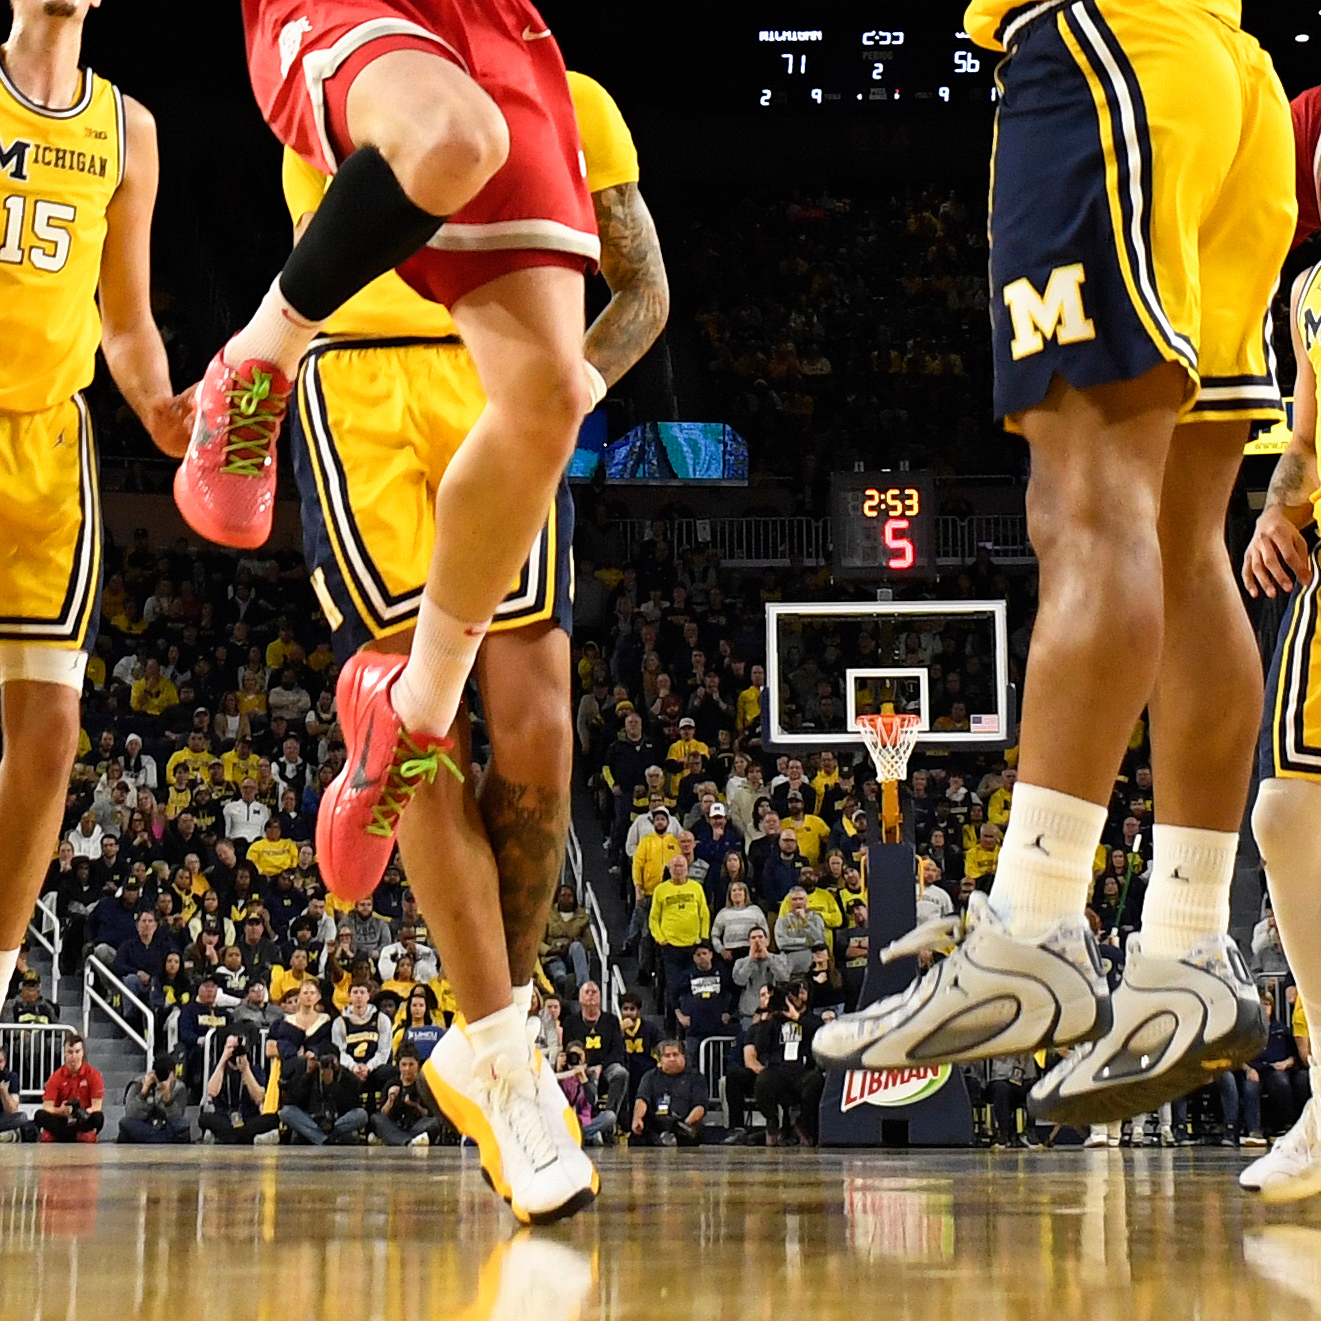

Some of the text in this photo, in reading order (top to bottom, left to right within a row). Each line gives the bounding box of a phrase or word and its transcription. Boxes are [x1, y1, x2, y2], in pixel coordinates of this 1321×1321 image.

[781, 53, 807, 75] 71
[871, 63, 884, 80] 2
[759, 88, 773, 107] 2
[1002, 262, 1097, 361] M
[862, 487, 920, 518] 2:53
[884, 518, 916, 570] 5
[844, 1063, 941, 1107] LIBMAN
